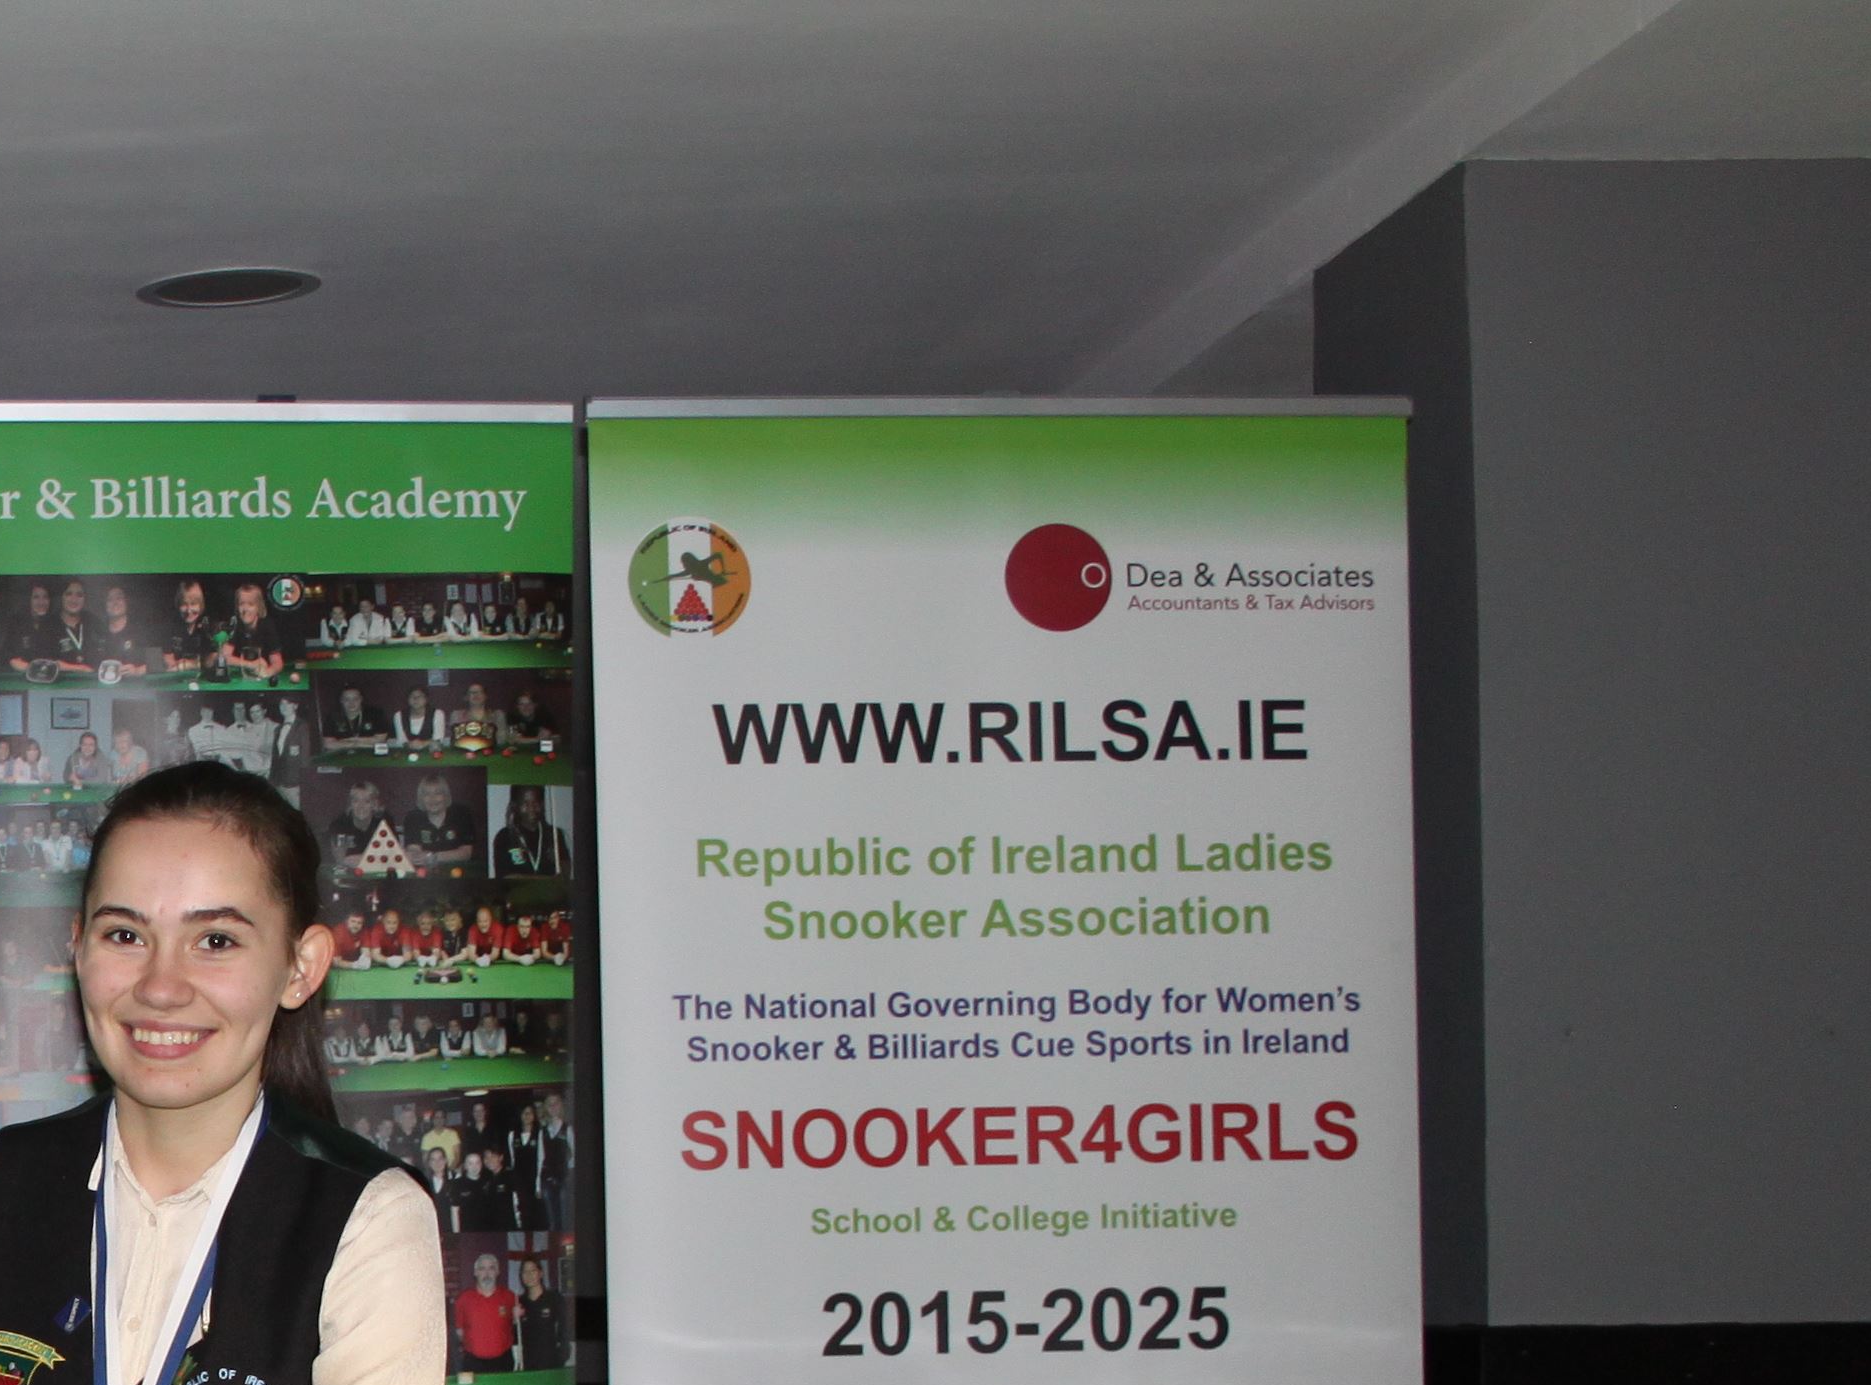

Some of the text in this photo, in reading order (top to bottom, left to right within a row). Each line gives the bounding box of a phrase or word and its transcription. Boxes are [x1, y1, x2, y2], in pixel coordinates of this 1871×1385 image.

[36, 479, 77, 521] &
[90, 476, 293, 520] Billiards
[306, 476, 528, 532] Academy
[1127, 563, 1375, 588] Dea & Associates
[1128, 594, 1375, 611] Accountants & Tax Advisors
[712, 700, 1308, 765] WWW.RILSA.IE
[697, 833, 1333, 887] Republic of Ireland Ladies
[764, 896, 1271, 941] Snooker Association
[673, 995, 733, 1021] The
[745, 993, 876, 1020] National
[888, 991, 1056, 1023] Governing
[1069, 989, 1152, 1021] Body
[1162, 988, 1208, 1014] for
[688, 1028, 1350, 1063] Snooker & Billiards Cue Sports in Ireland
[682, 1101, 1359, 1171] SNOOKER4GIRLS
[812, 1202, 1238, 1238] School & College Initiative
[823, 1287, 1230, 1357] 2015-2025
[218, 1368, 237, 1380] OF
